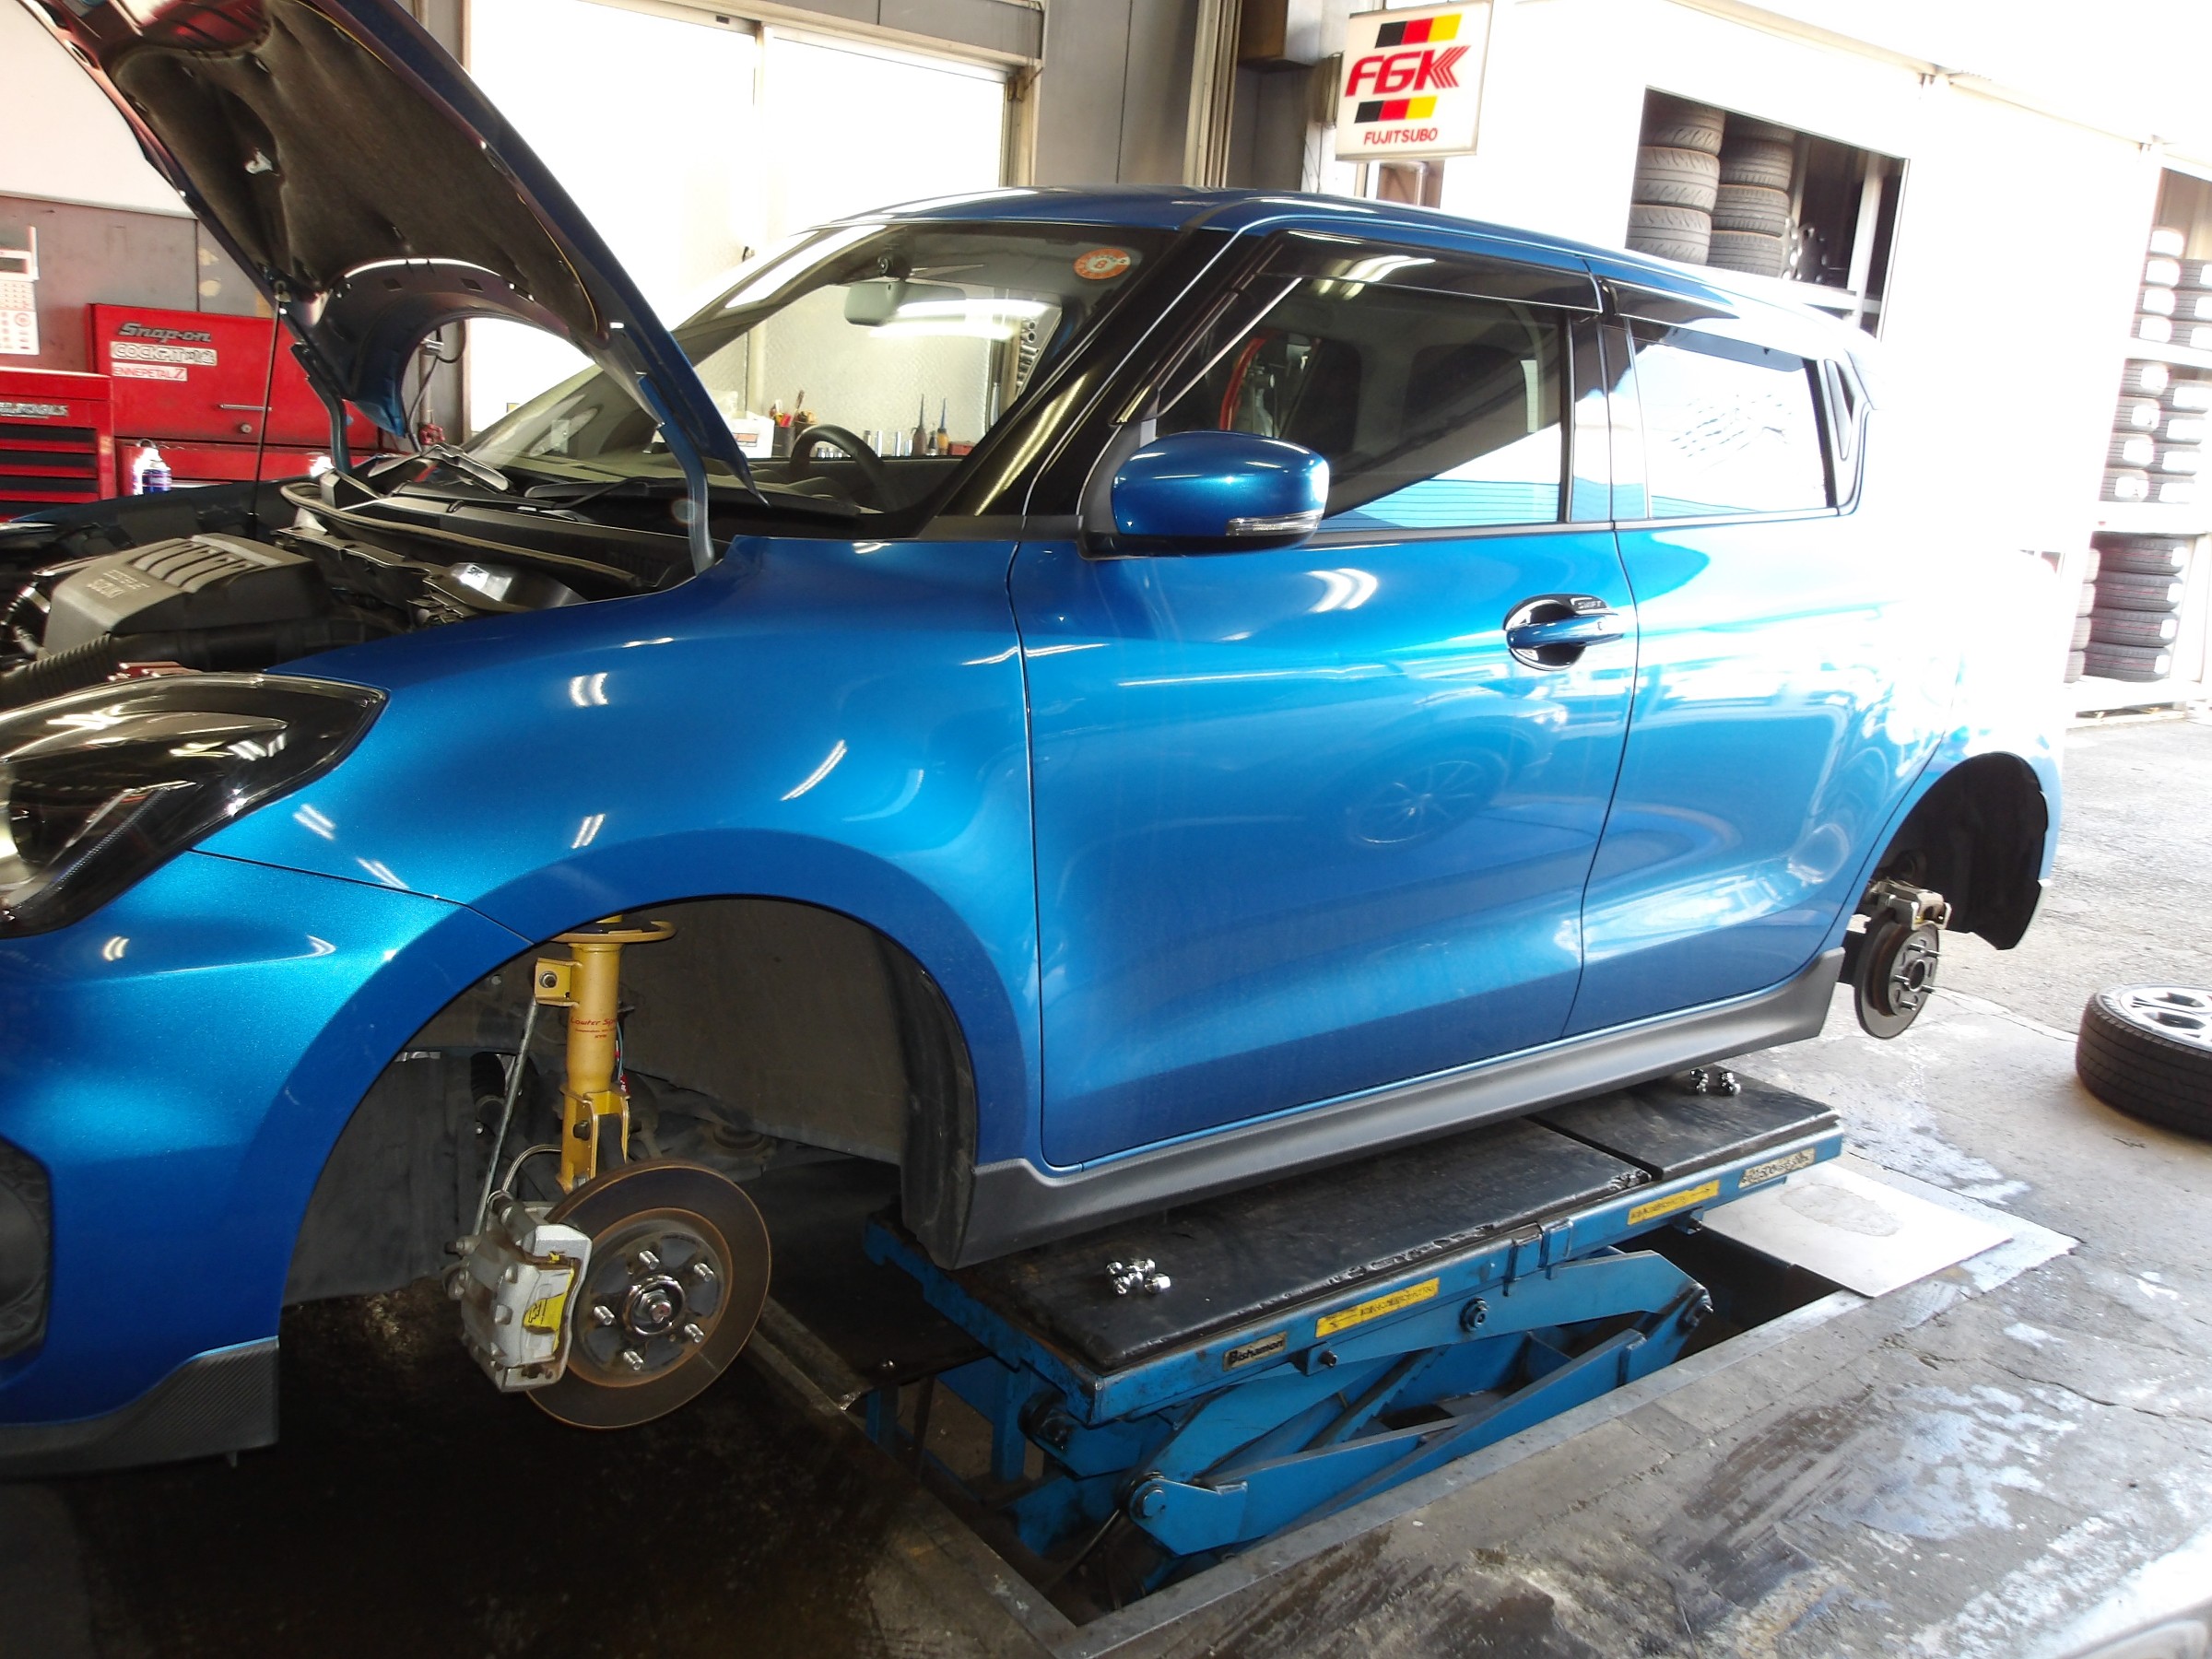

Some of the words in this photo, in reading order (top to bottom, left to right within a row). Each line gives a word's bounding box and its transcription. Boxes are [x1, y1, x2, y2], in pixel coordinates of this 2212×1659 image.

[1345, 44, 1471, 98] FGK
[1364, 127, 1439, 146] FUJITSUBO
[118, 322, 211, 343] Snap-on
